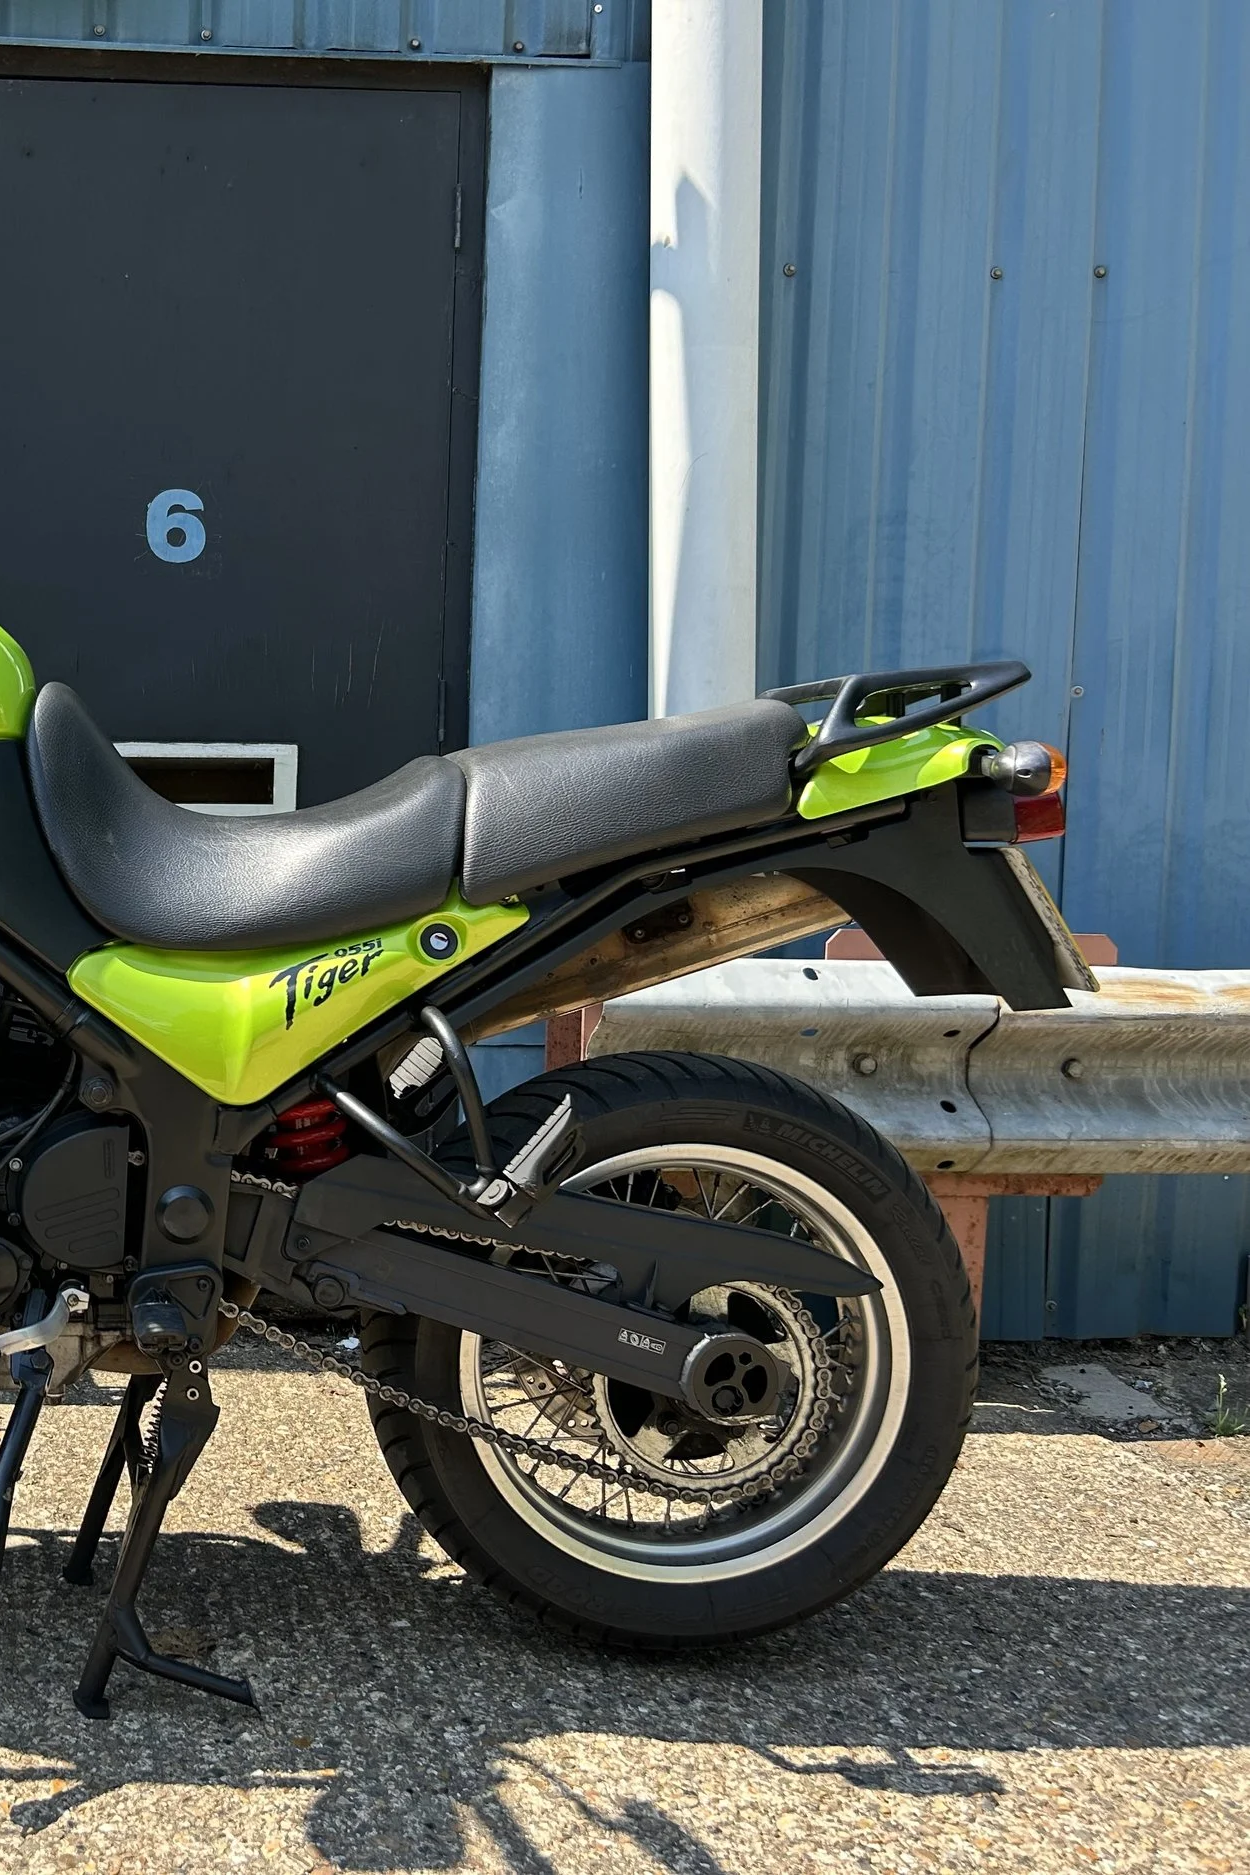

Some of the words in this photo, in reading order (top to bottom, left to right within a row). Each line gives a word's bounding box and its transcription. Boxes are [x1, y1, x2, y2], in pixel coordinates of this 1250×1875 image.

[146, 488, 207, 563] 6
[268, 949, 385, 1030] Tiger
[774, 1122, 891, 1197] MICHELIN
